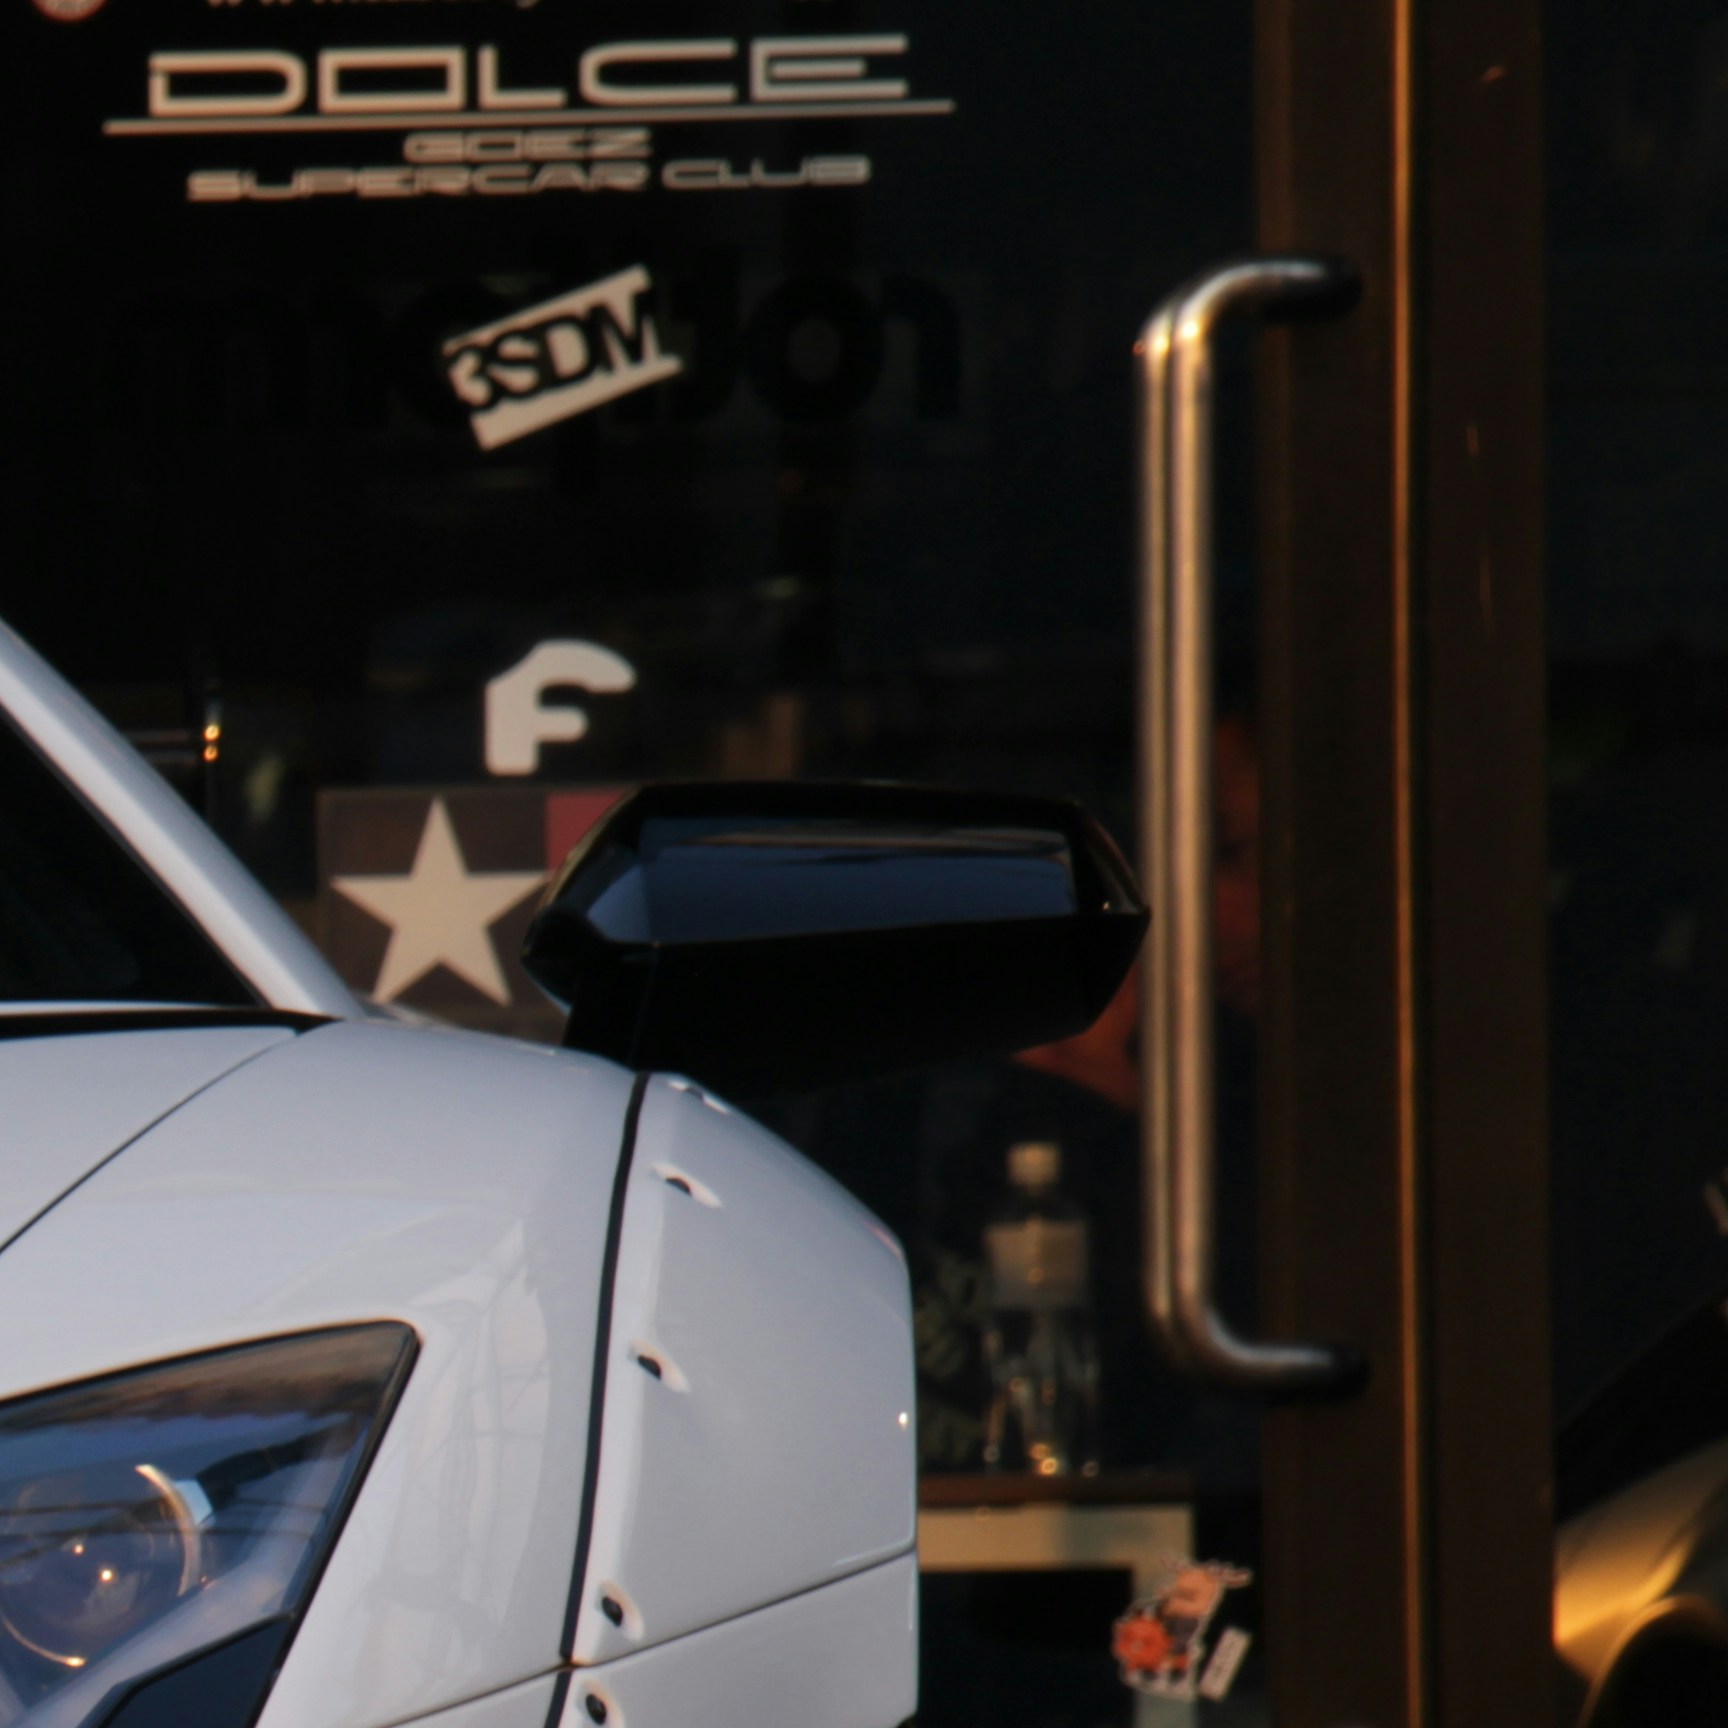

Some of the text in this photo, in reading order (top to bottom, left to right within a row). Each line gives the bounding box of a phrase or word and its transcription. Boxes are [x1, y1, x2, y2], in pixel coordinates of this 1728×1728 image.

[148, 34, 908, 116] DOLCE
[187, 156, 870, 200] SUPERCAR CLUB
